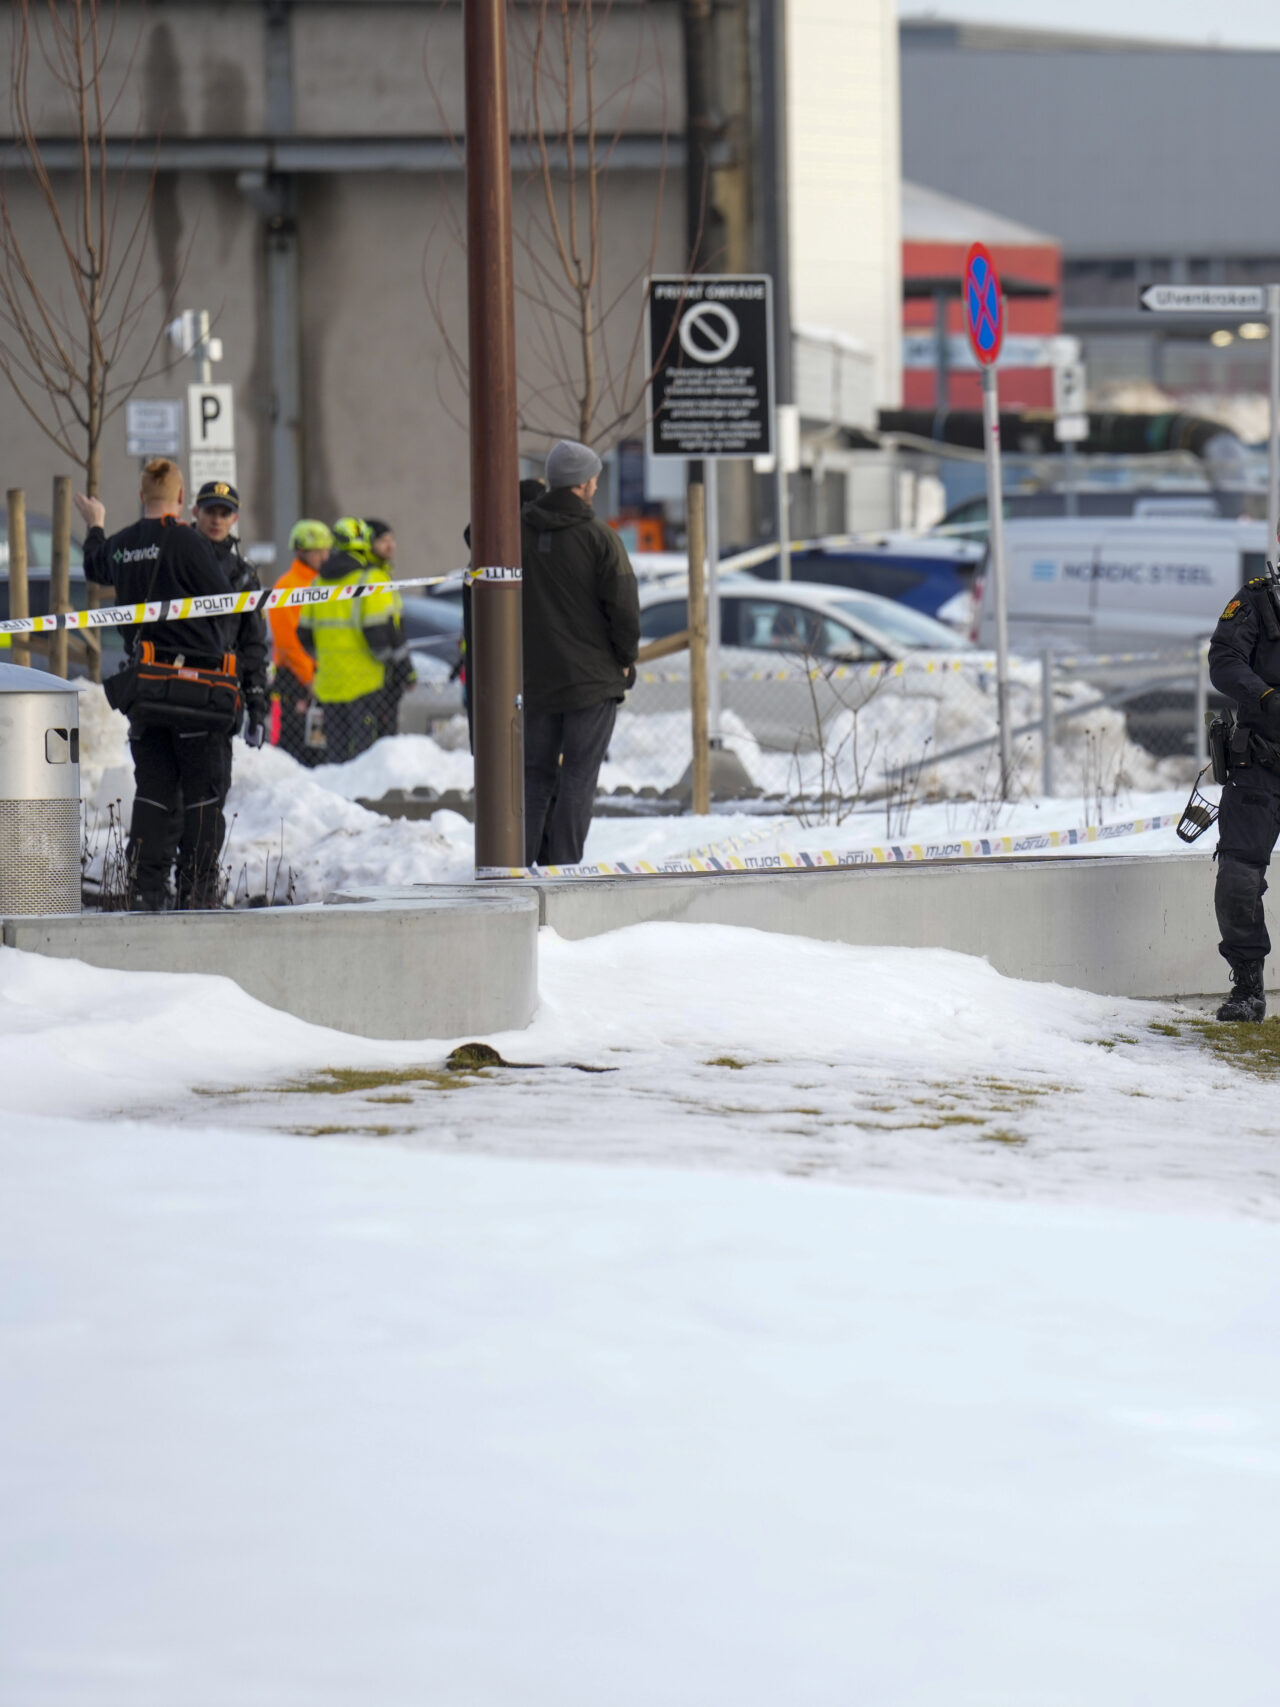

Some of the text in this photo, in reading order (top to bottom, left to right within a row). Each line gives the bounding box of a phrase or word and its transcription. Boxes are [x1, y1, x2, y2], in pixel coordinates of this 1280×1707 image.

[655, 284, 704, 300] PRIVAT
[202, 395, 220, 438] P
[485, 567, 522, 579] OLITI
[1064, 562, 1213, 586] NORDIC STEEL
[291, 587, 329, 604] POLITI
[194, 596, 234, 612] POLITI
[0, 618, 31, 631] OLITI
[90, 610, 132, 626] POLITI
